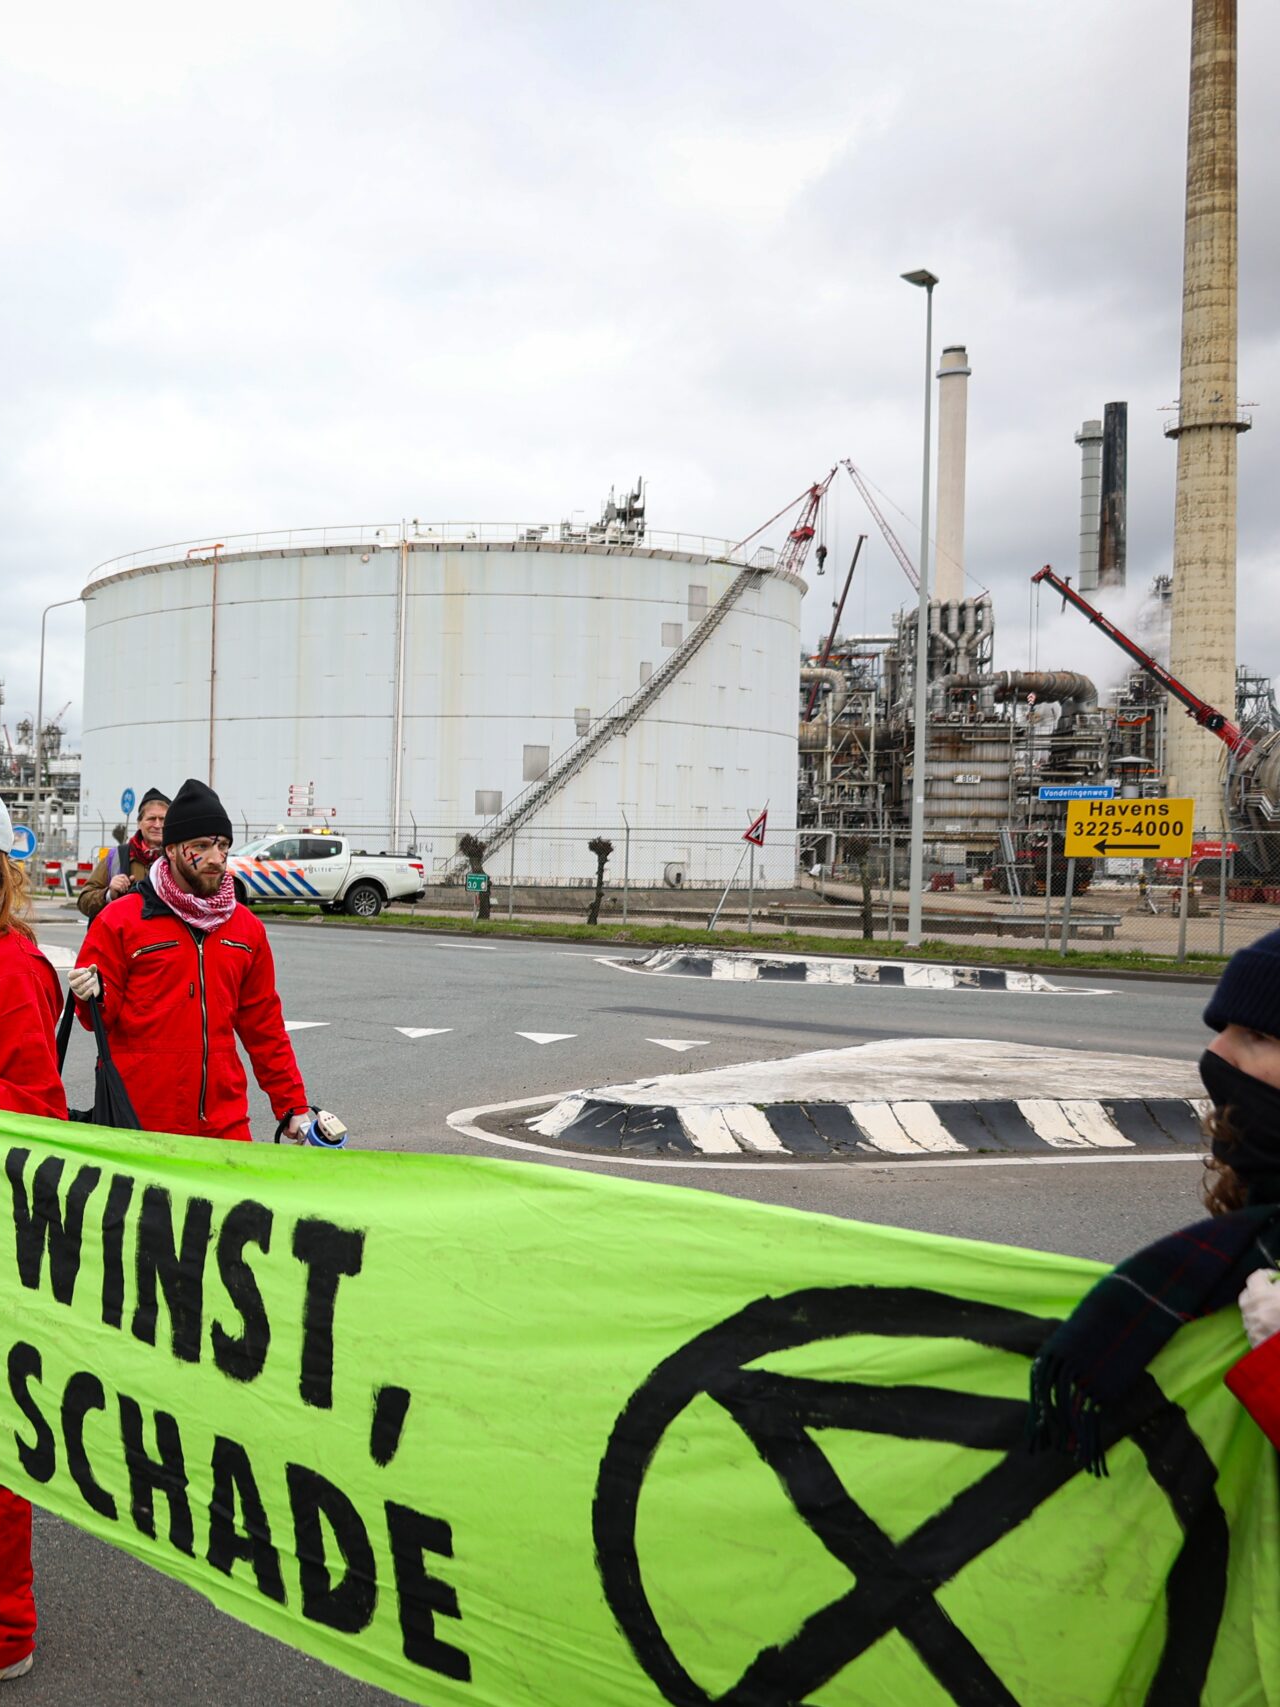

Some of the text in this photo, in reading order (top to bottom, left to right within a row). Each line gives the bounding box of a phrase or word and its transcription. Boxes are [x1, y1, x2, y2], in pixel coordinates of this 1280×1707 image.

[1043, 789, 1109, 798] Vondelingenweg
[1089, 801, 1170, 817] Havens
[1073, 820, 1184, 837] 3225-4000
[5, 1147, 411, 1468] WINST,
[7, 1341, 472, 1683] SCHADE
